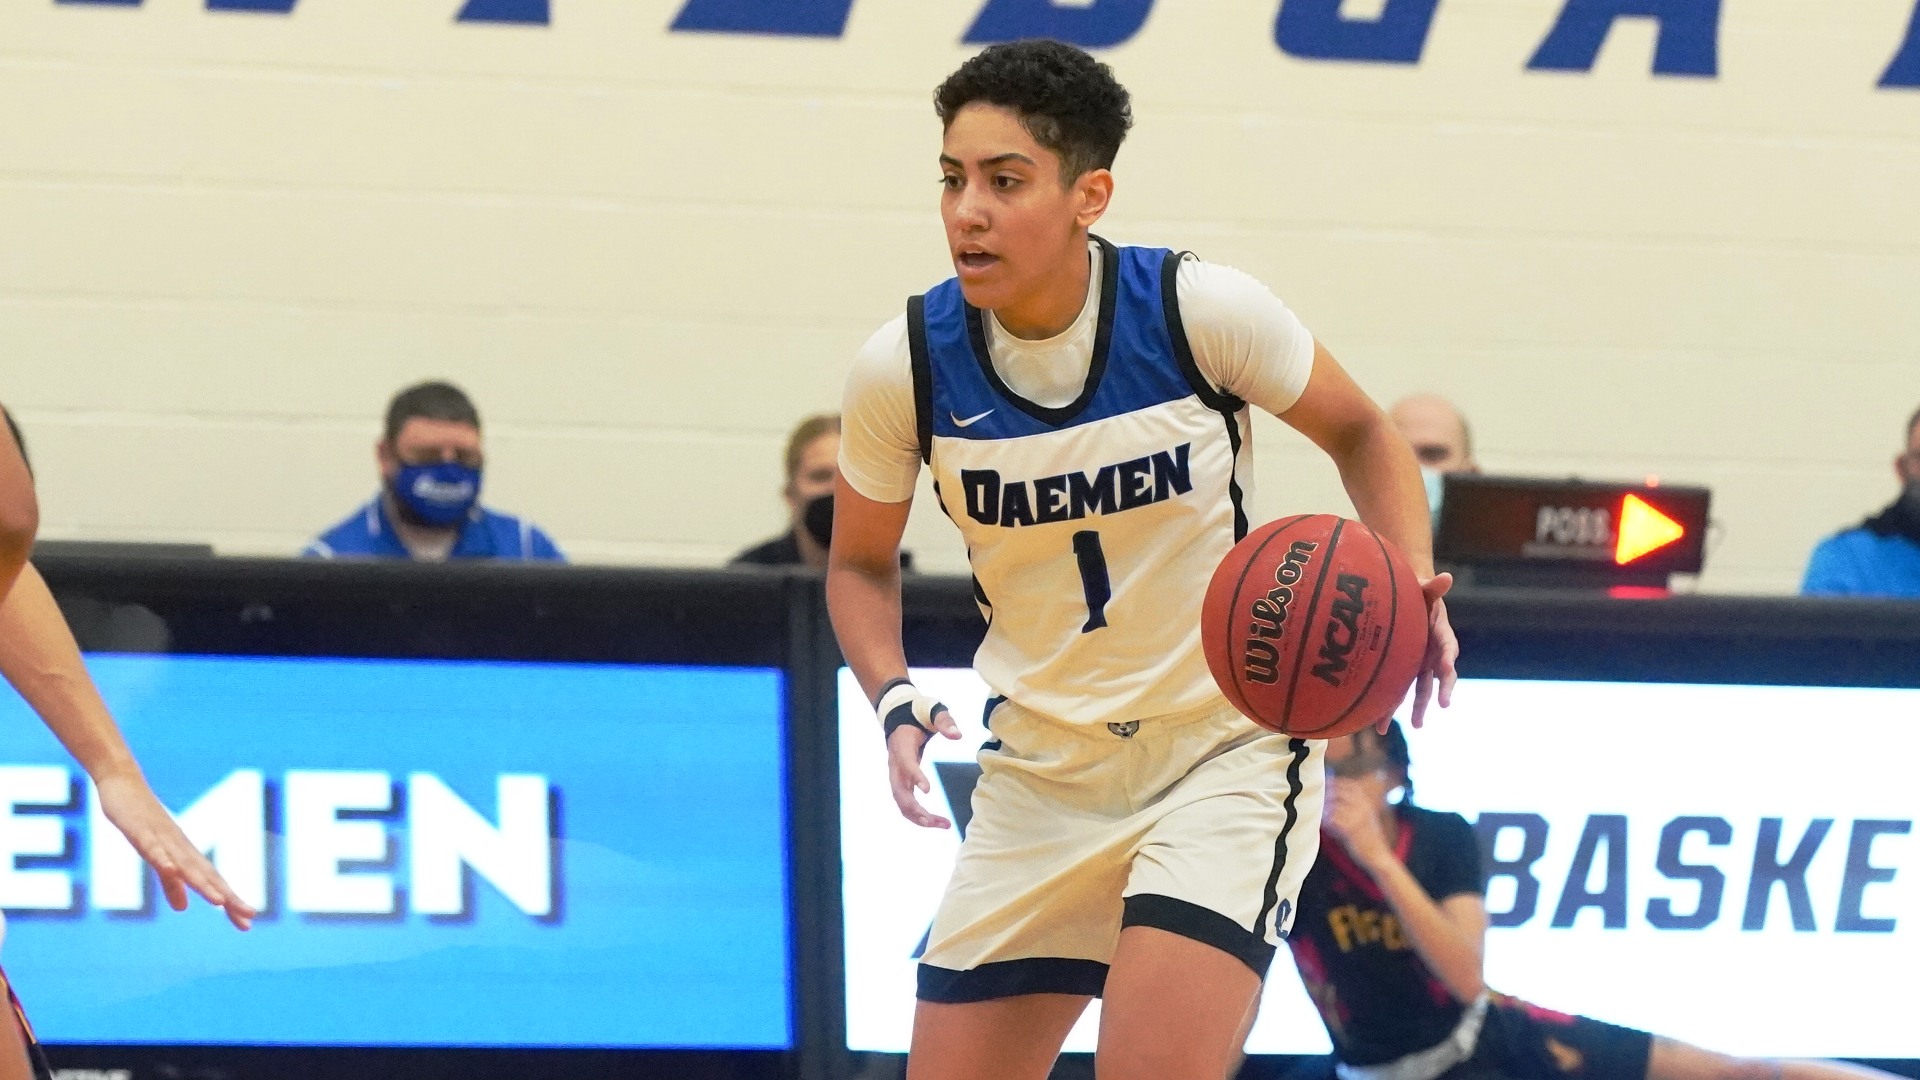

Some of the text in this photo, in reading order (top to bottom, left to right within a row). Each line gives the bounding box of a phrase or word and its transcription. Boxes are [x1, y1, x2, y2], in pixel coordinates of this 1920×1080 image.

[961, 442, 1193, 528] DAEMEN
[1073, 530, 1111, 633] 1
[1245, 539, 1319, 686] Wilson
[1310, 573, 1369, 688] NCAA
[1475, 811, 1913, 933] BASKE
